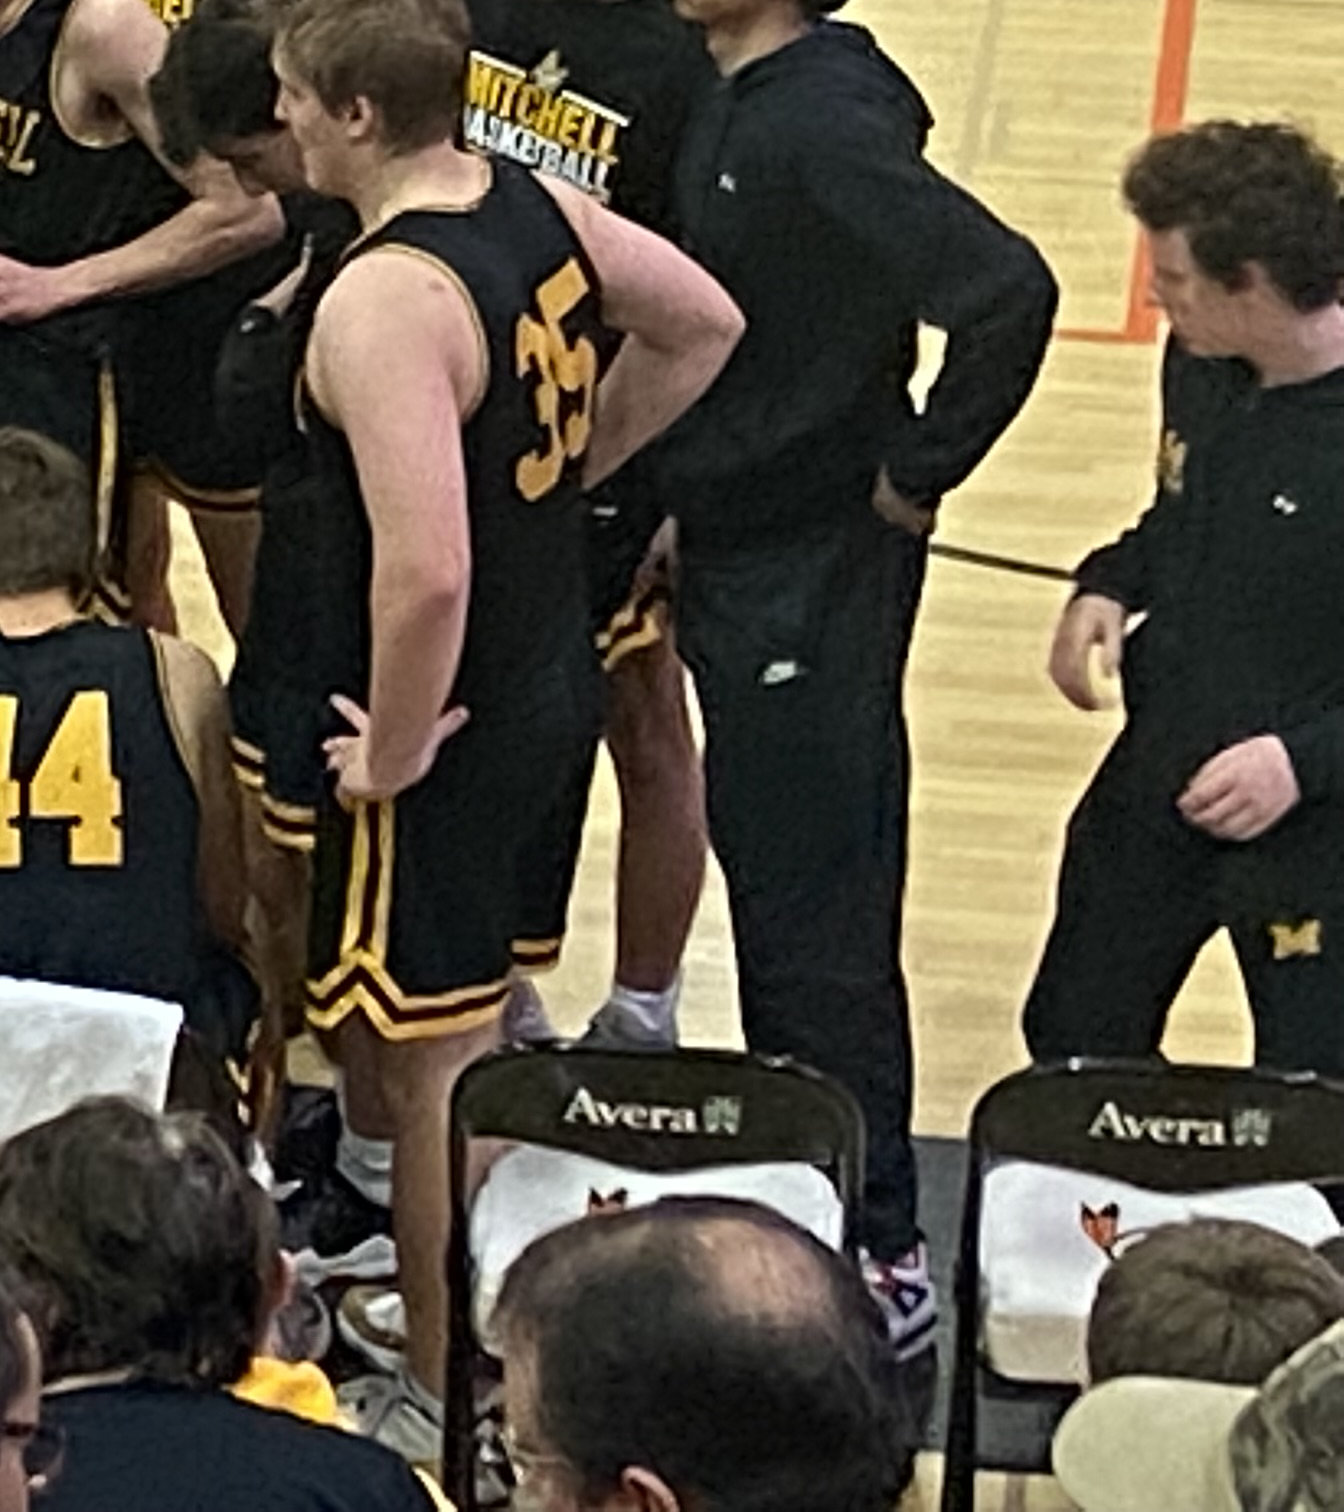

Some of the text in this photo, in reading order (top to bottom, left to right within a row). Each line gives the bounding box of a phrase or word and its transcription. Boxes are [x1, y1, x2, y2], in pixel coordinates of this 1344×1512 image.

[515, 256, 598, 503] 35
[563, 1086, 698, 1134] Avera
[1088, 1101, 1226, 1147] Avera
